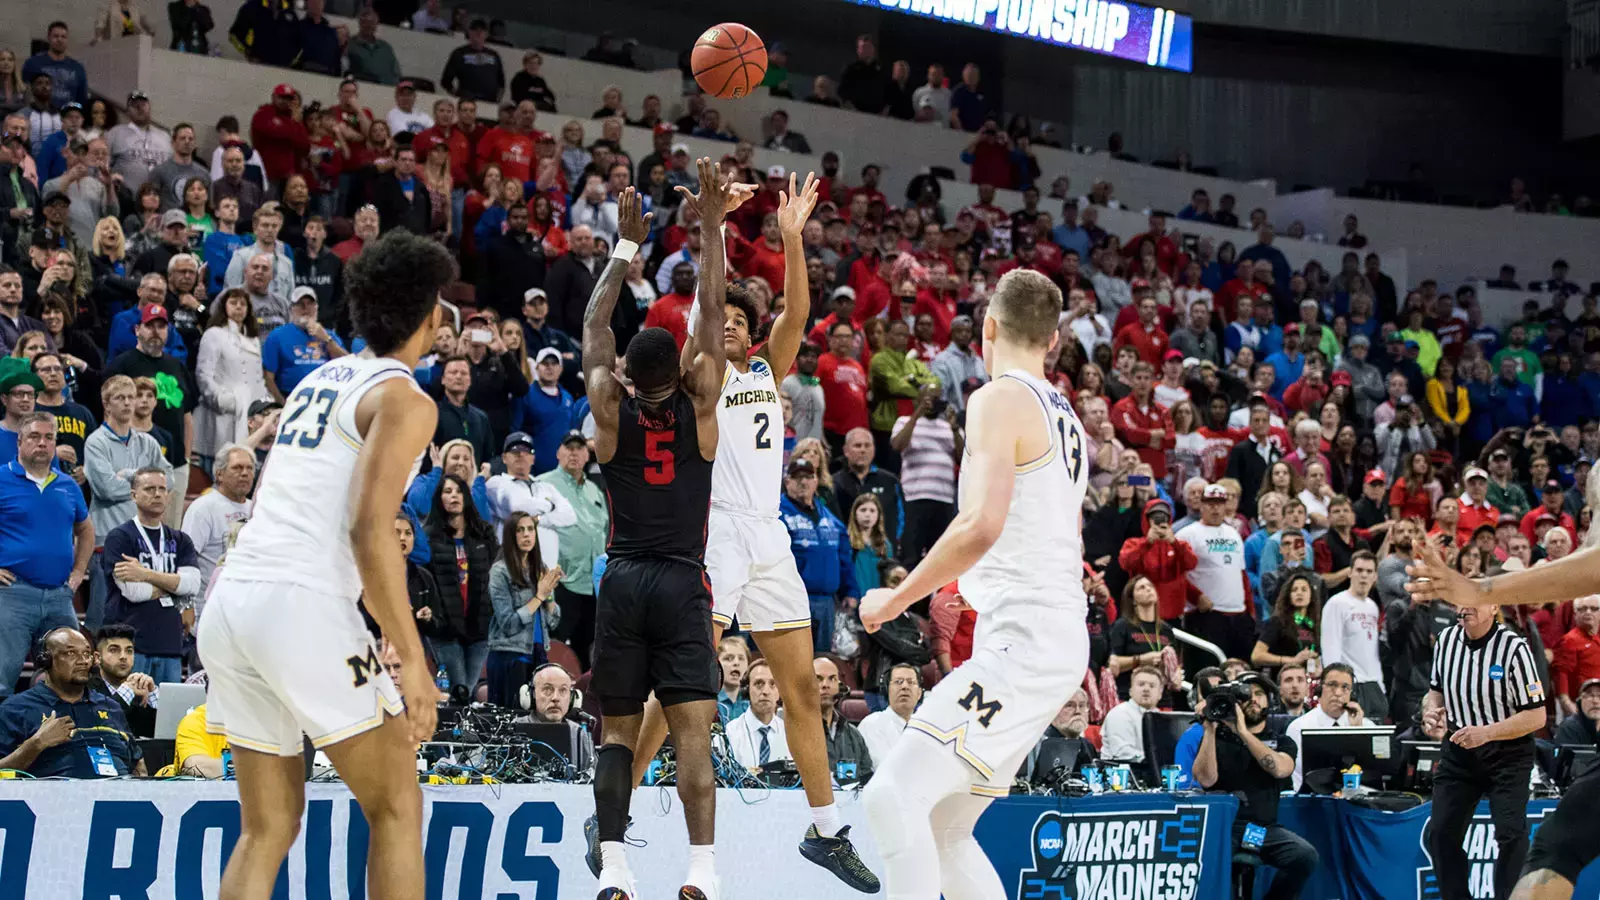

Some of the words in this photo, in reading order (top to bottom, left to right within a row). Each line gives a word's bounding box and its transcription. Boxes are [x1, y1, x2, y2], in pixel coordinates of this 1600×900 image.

[880, 0, 1130, 53] MPIONSHIP
[277, 386, 339, 449] 23
[754, 412, 772, 450] 2
[644, 430, 676, 486] 5
[1057, 415, 1082, 485] 13
[346, 643, 383, 689] M
[957, 680, 1003, 729] M
[1040, 838, 1063, 850] NCAA
[1061, 820, 1158, 863] MARCH
[1075, 862, 1199, 900] MADNESS
